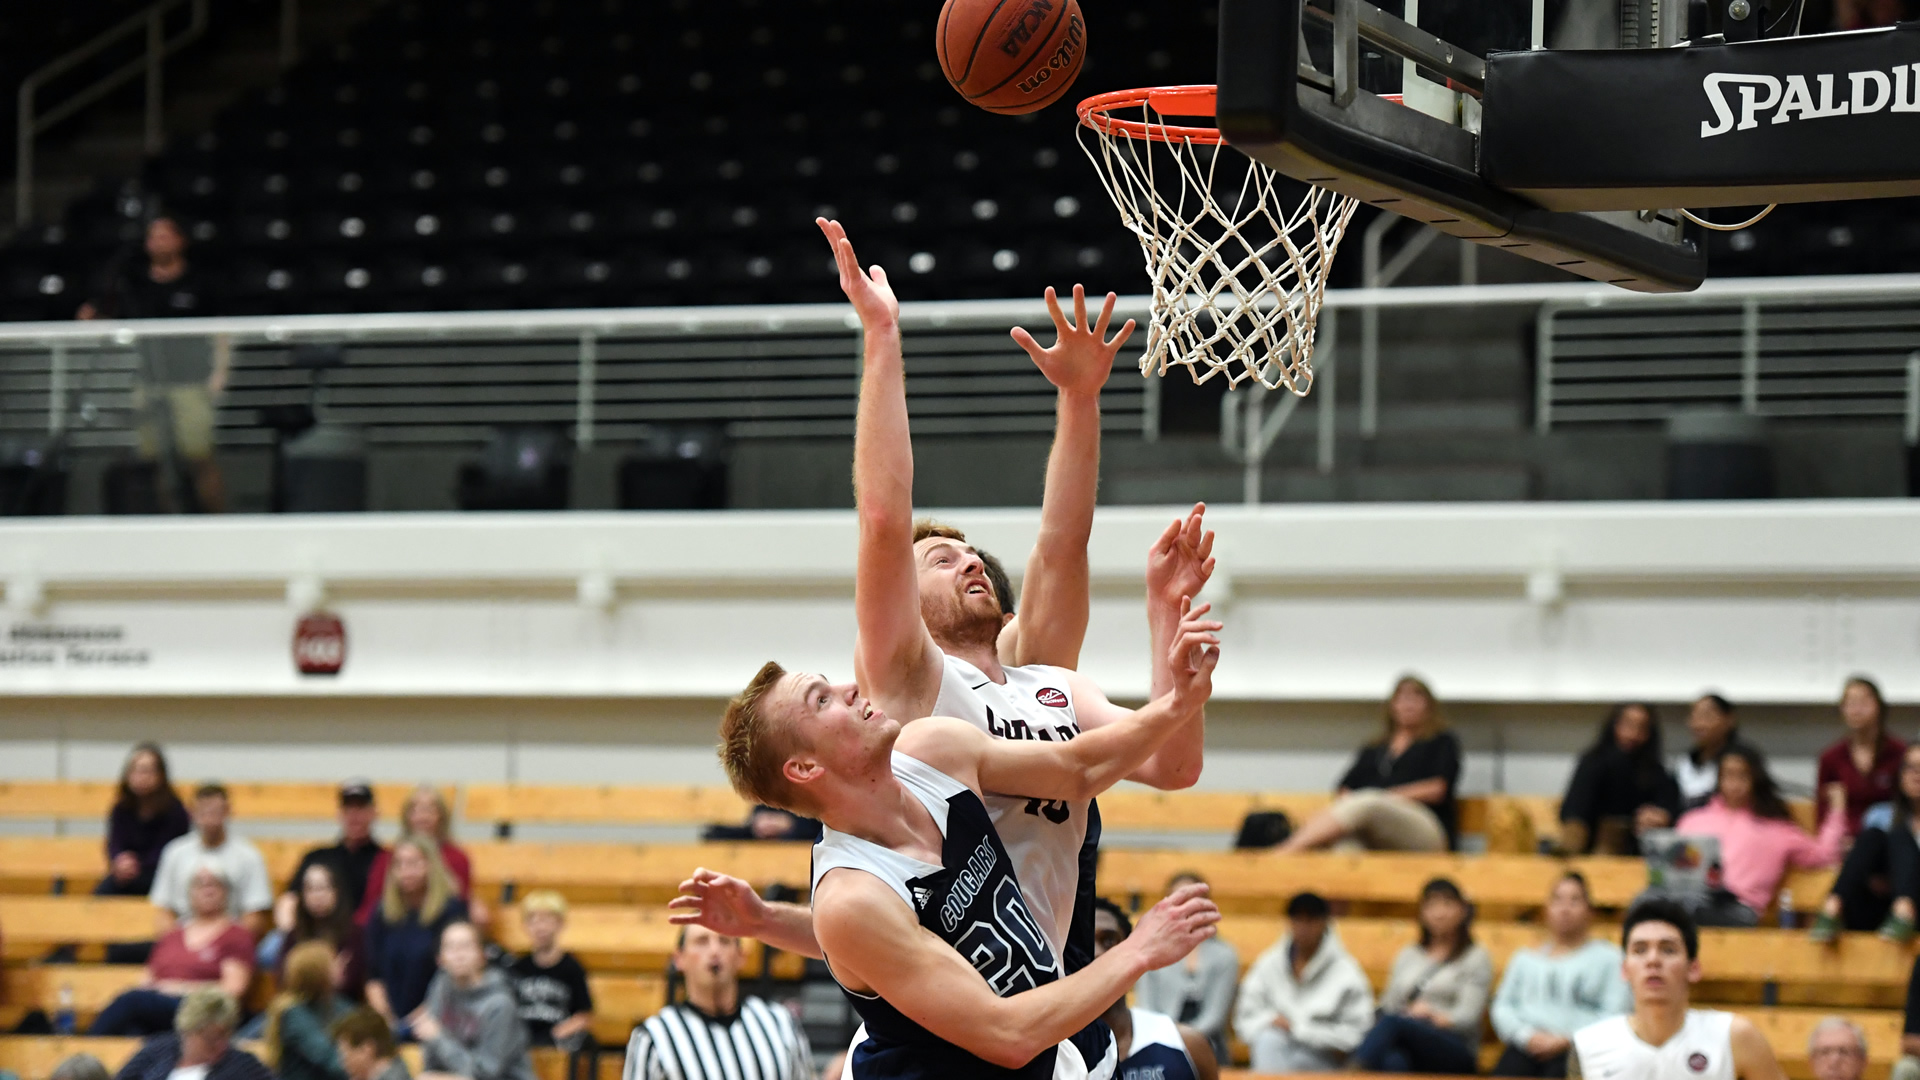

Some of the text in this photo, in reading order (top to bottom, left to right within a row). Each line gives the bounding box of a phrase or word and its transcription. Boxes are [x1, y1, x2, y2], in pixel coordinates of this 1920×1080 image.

[1016, 13, 1084, 94] Wilson
[940, 834, 998, 933] COUGARS
[954, 873, 1058, 998] 20
